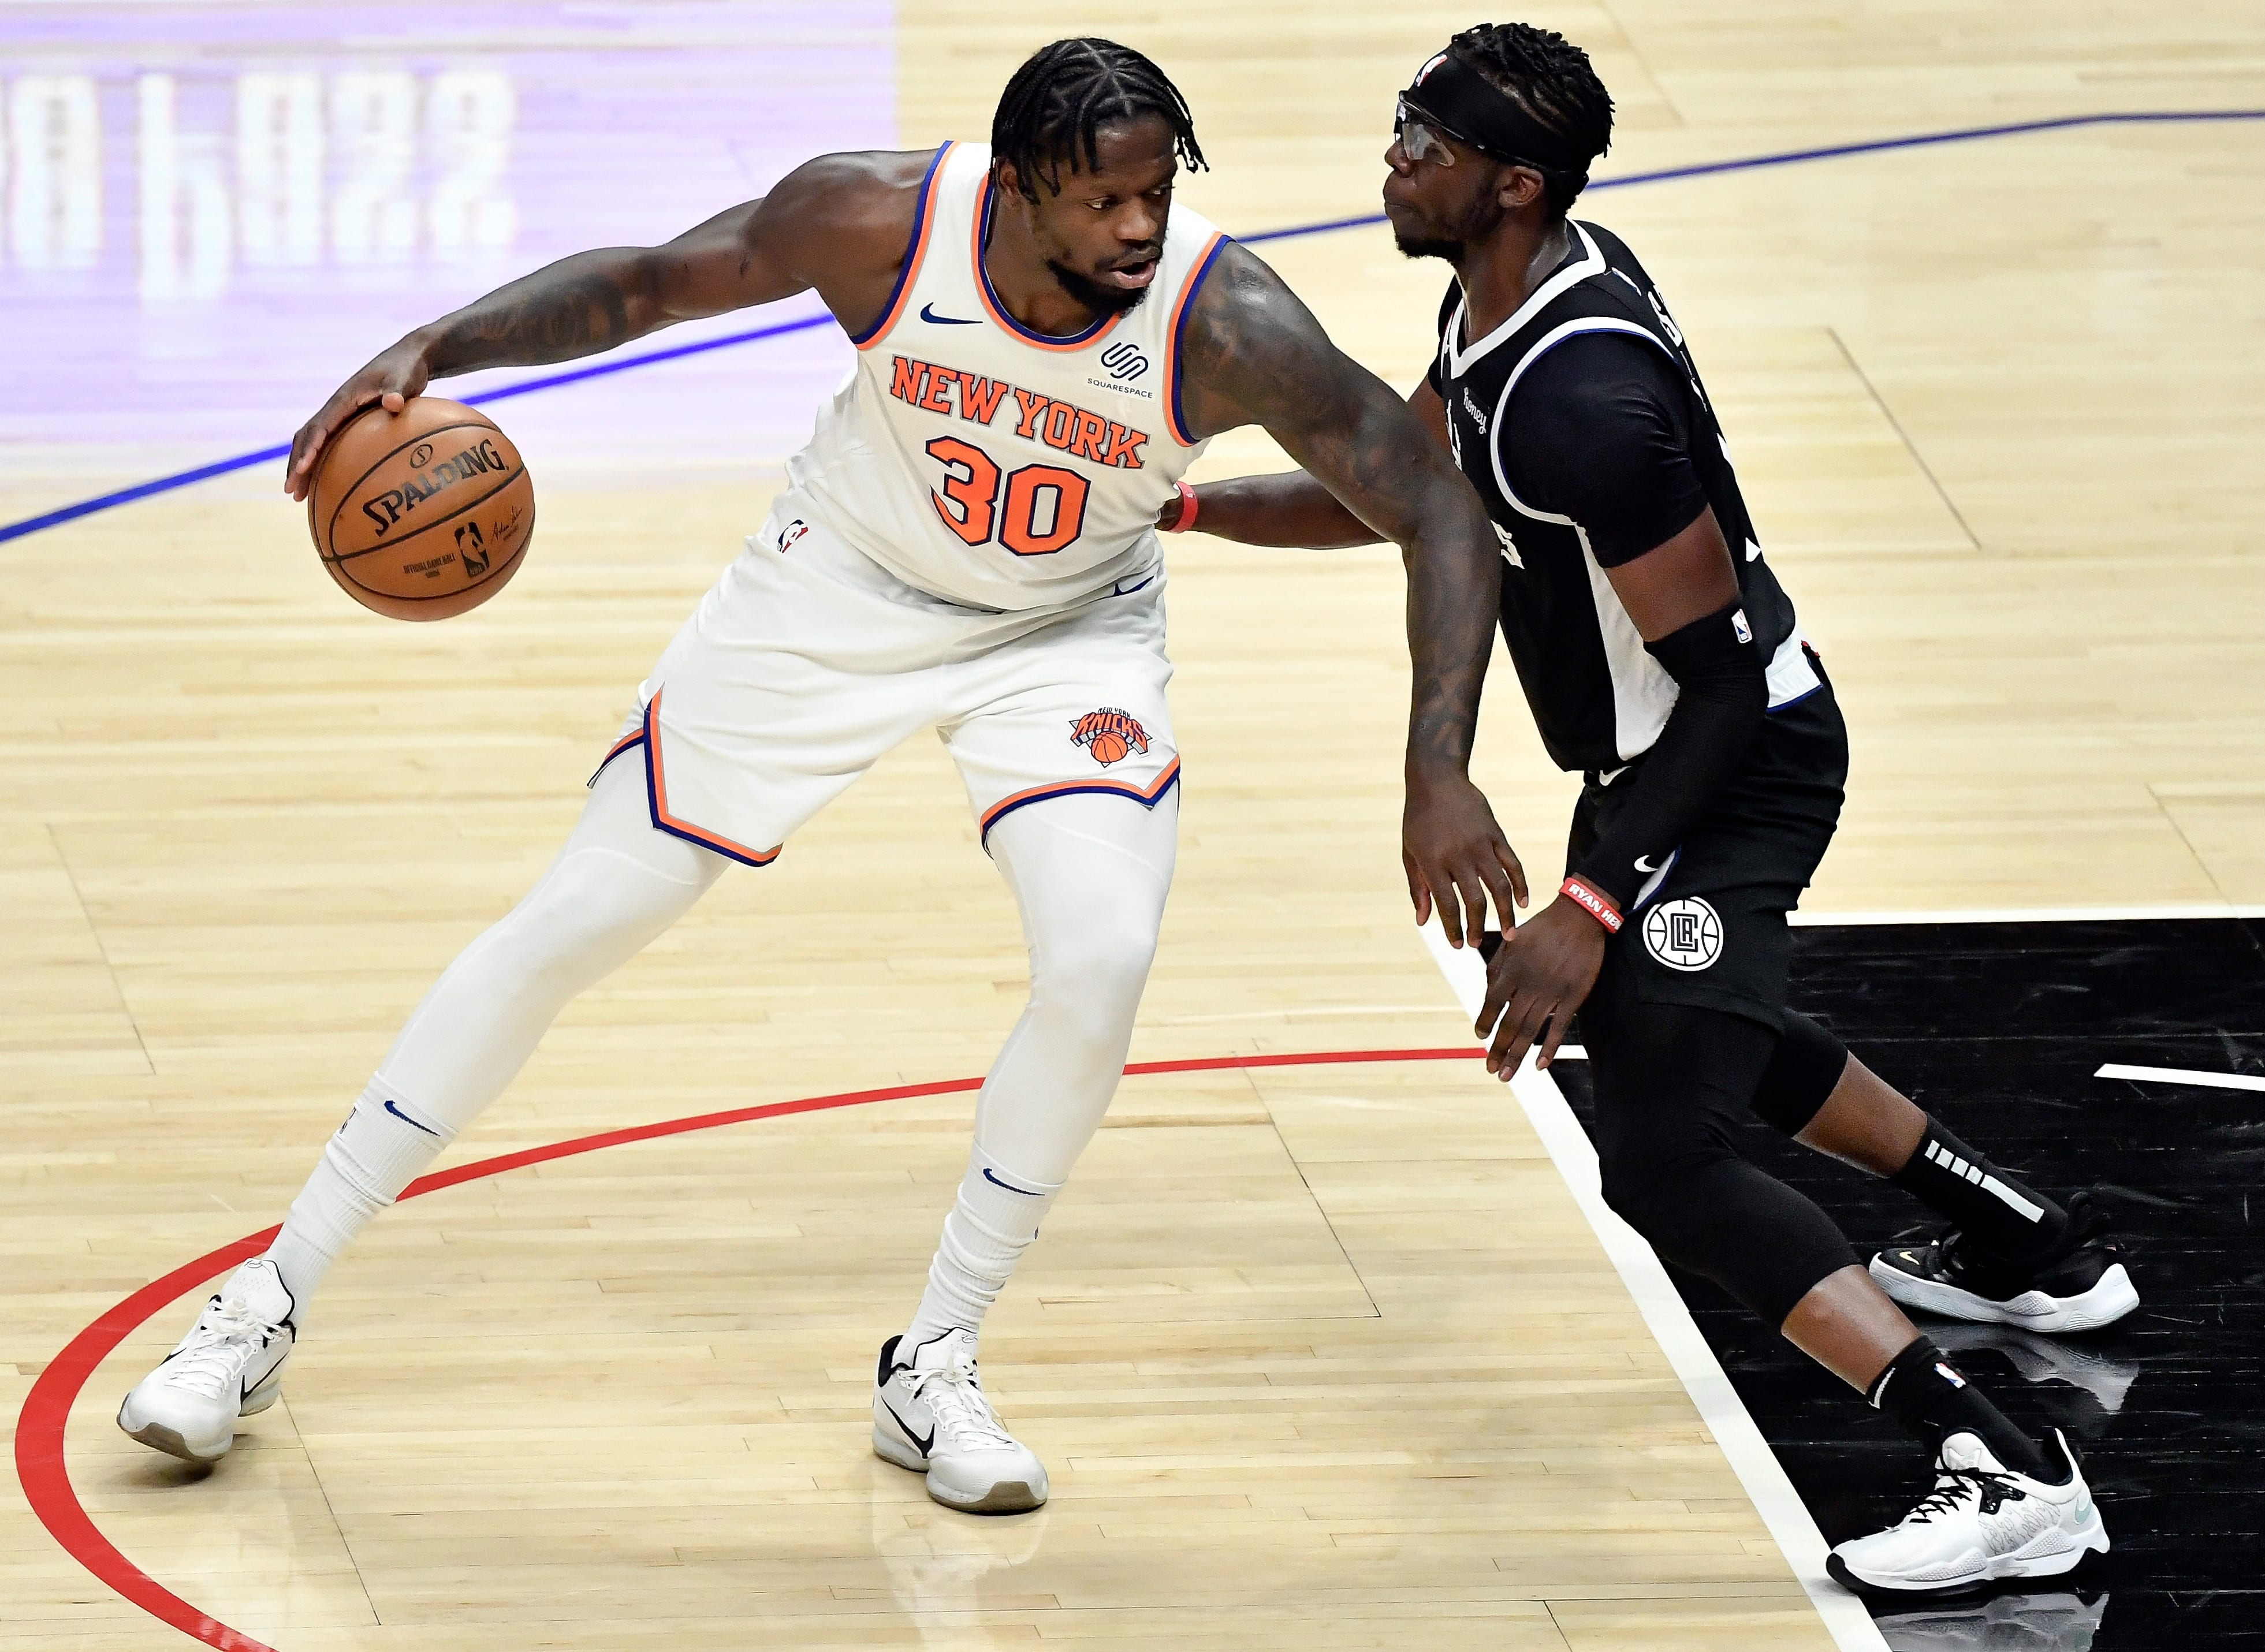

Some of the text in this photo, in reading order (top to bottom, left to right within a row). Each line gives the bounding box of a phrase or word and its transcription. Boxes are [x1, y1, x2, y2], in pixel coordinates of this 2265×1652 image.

[890, 353, 1150, 469] NEW YORK
[1087, 378, 1153, 399] SQUARESPACE
[1463, 387, 1487, 435] honey
[363, 438, 506, 537] SPALDING
[925, 435, 1091, 557] 30
[1070, 712, 1148, 754] KNICKS
[1097, 706, 1131, 720] NEW YORK
[1568, 883, 1603, 913] RYAN
